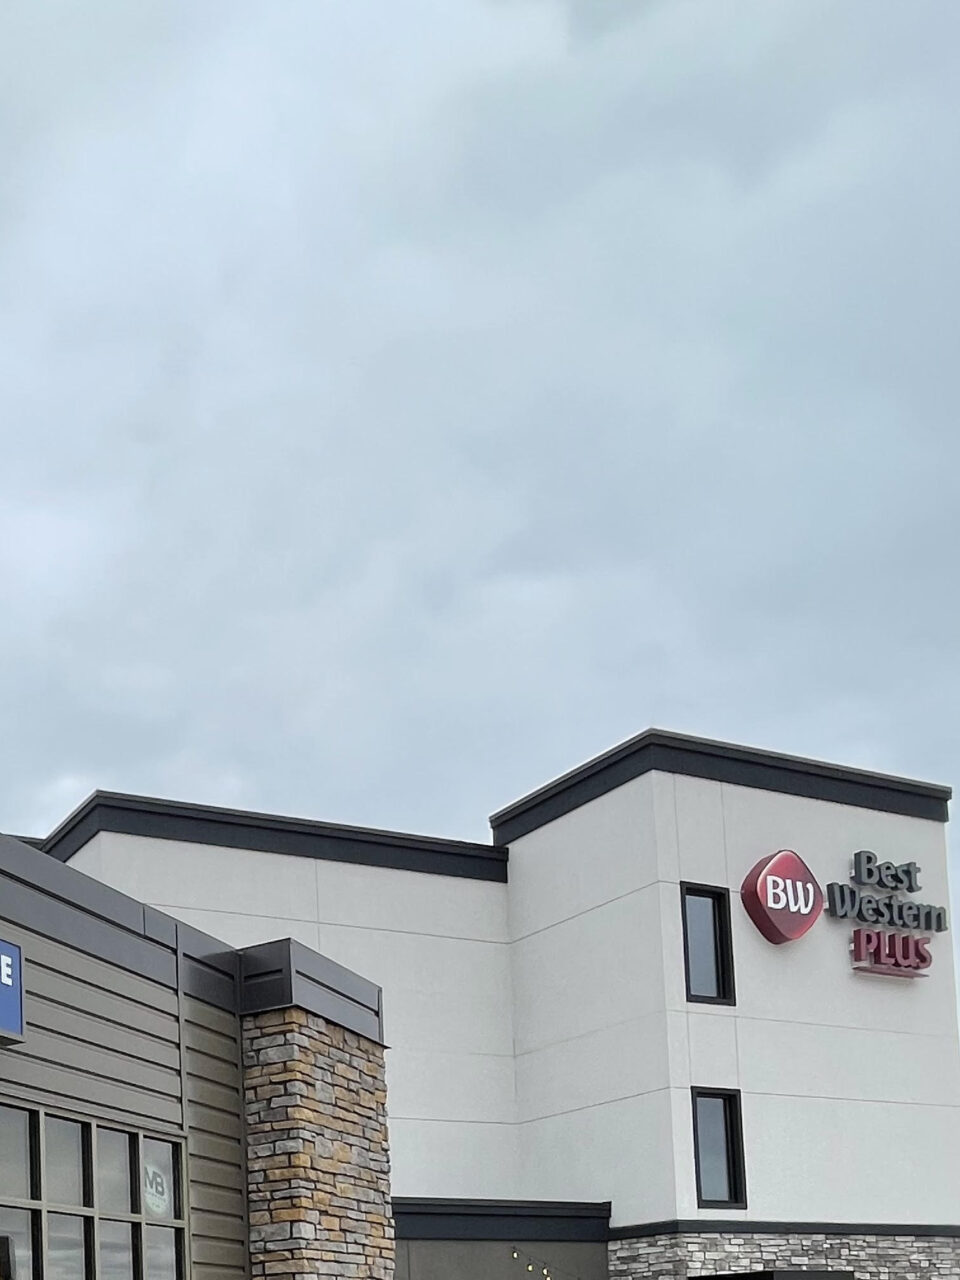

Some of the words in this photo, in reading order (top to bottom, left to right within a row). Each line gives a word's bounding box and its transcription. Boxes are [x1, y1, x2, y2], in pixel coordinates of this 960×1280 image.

[853, 850, 922, 893] Best
[766, 875, 815, 916] BW
[826, 882, 949, 933] Western
